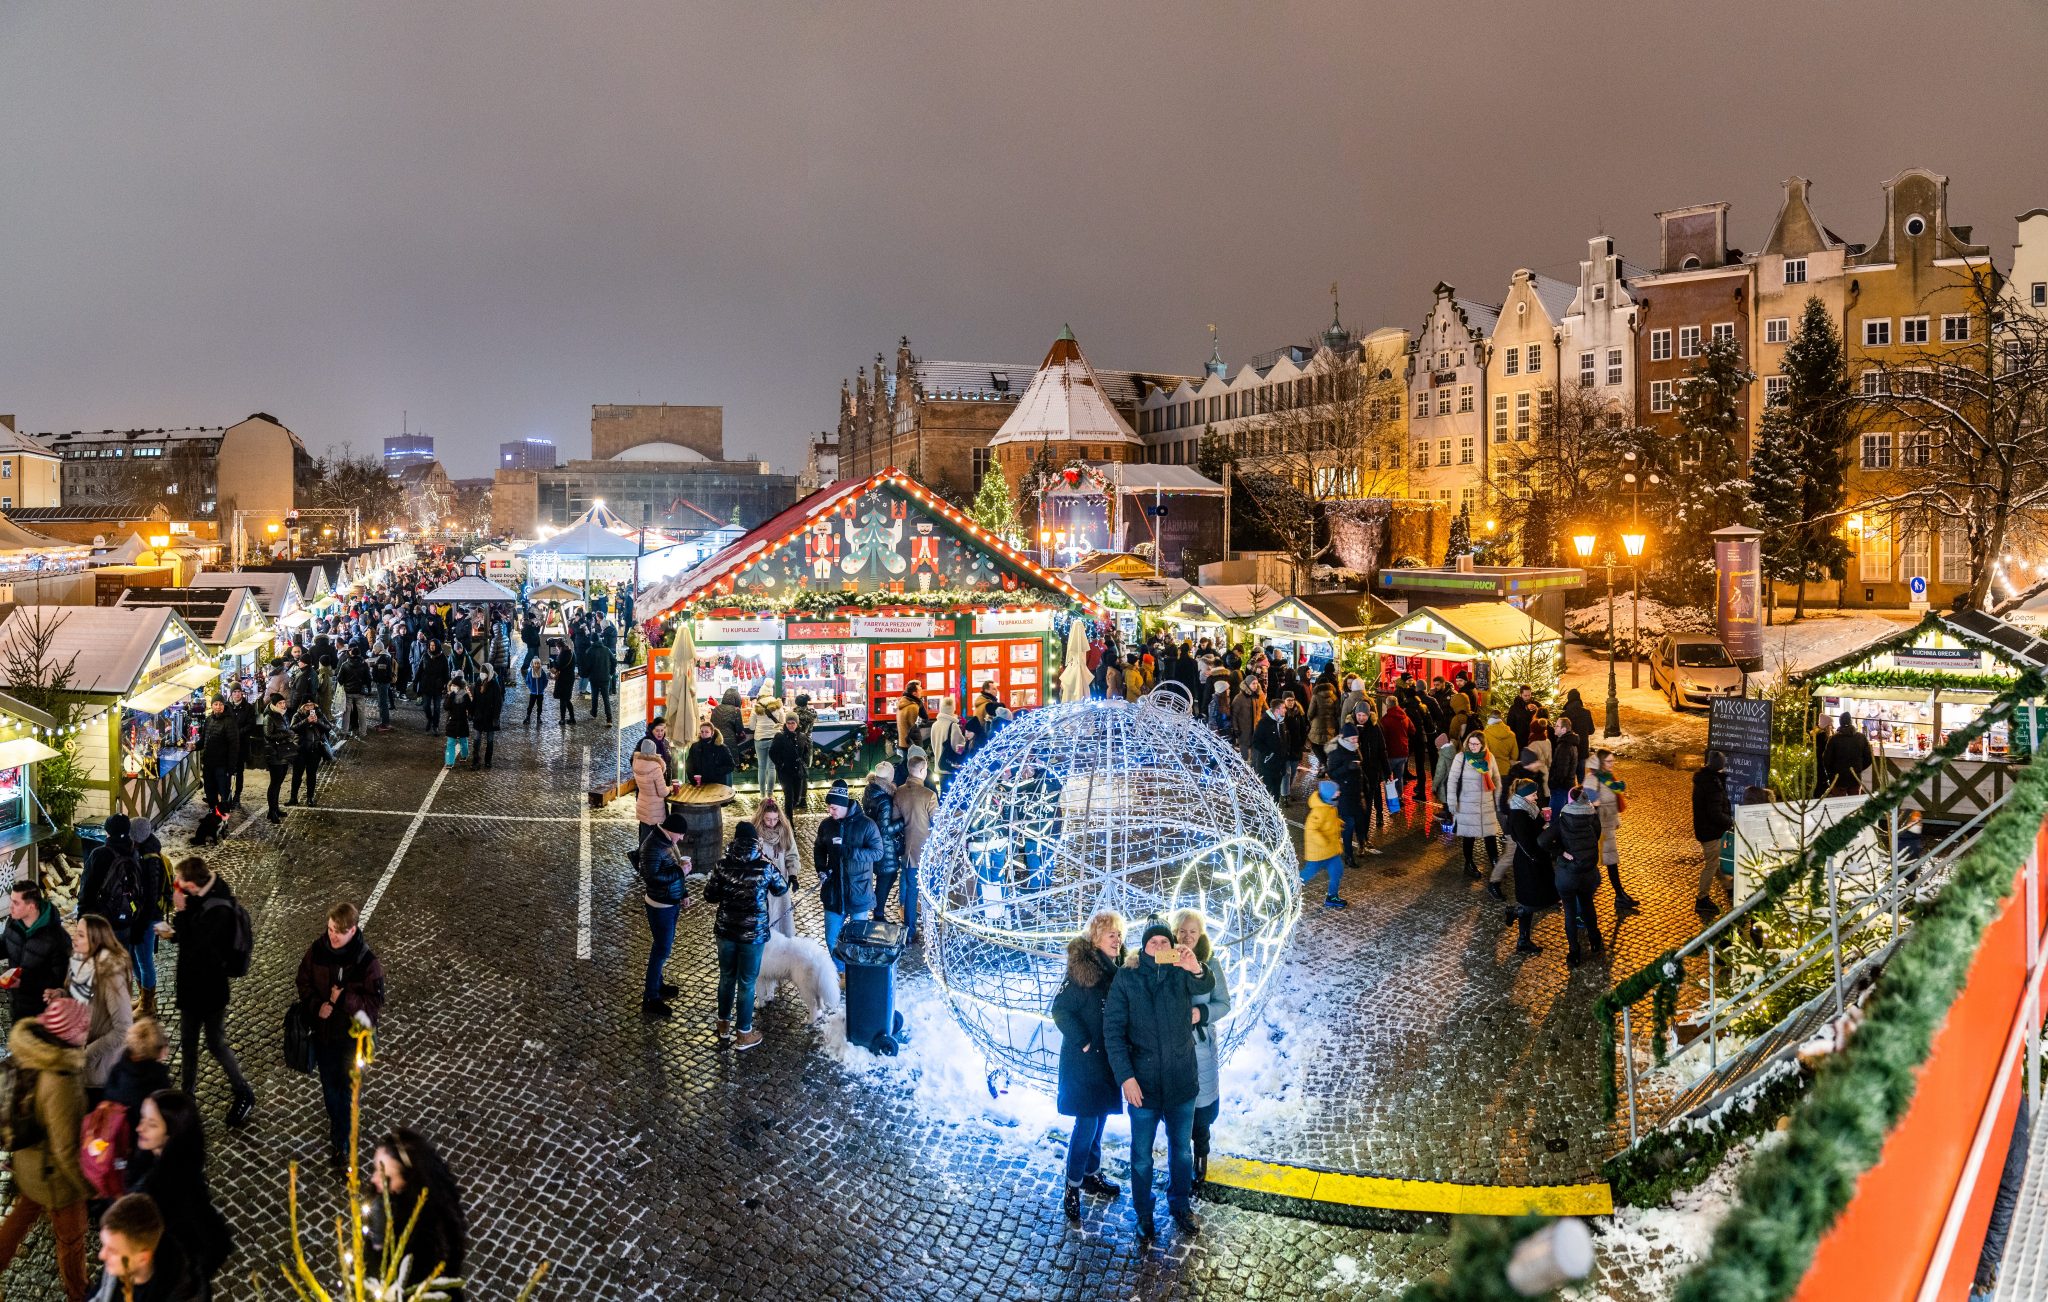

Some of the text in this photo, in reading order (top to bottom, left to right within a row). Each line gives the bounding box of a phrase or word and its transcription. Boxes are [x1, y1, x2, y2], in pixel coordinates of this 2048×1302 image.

[1473, 580, 1496, 590] RUCH
[2014, 614, 2036, 622] pepsi
[1713, 699, 1767, 719] MYKONOS
